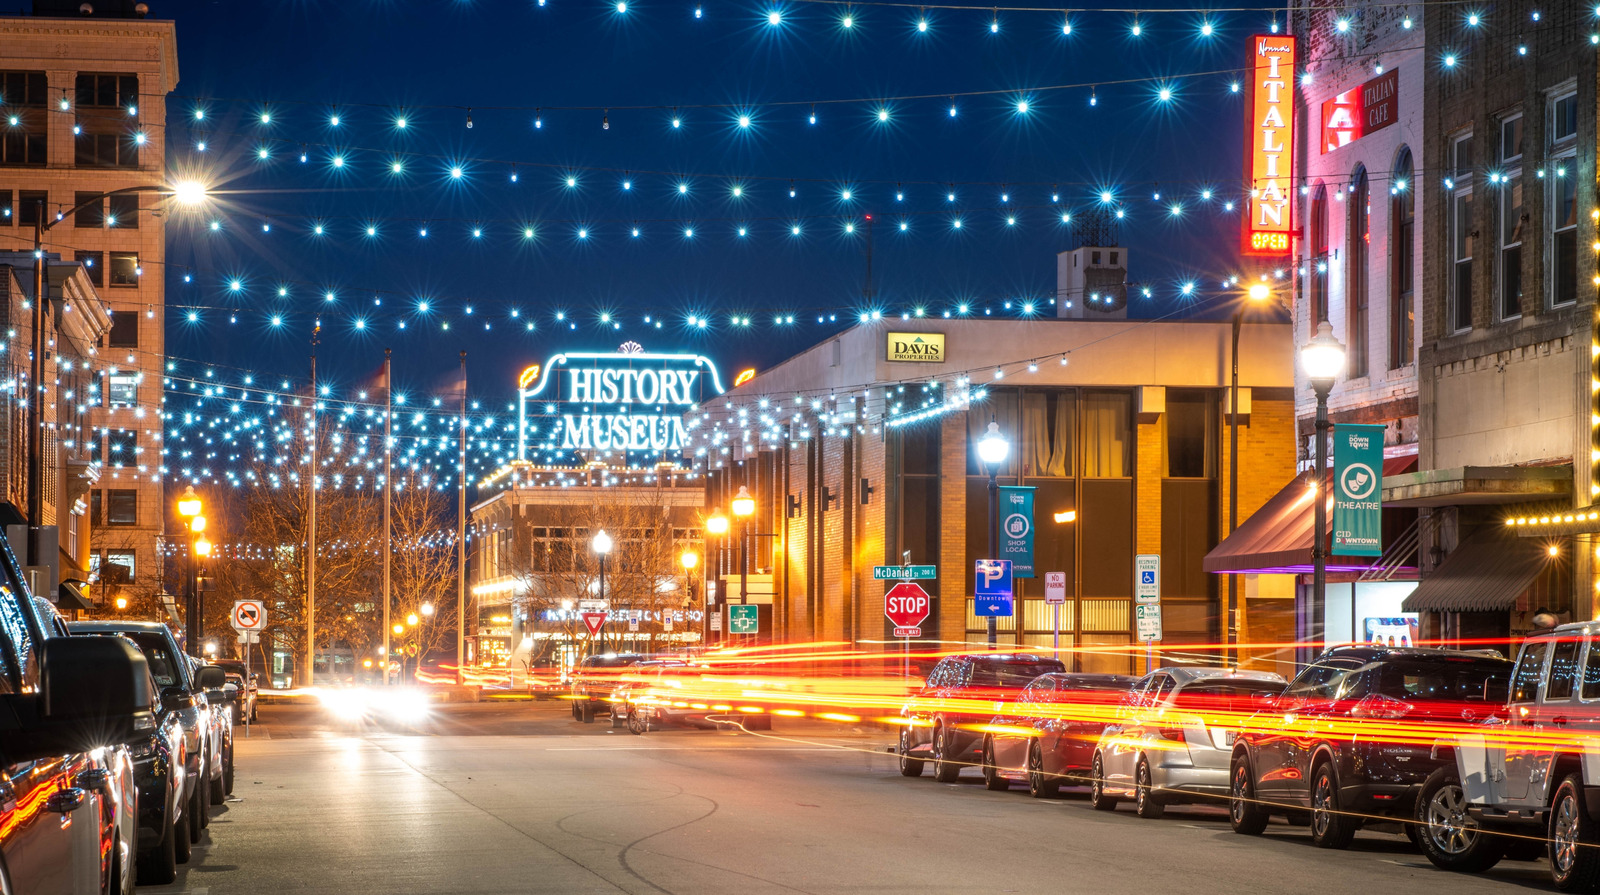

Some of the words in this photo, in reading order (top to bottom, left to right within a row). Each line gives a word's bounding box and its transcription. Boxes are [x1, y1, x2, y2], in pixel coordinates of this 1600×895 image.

[1258, 38, 1291, 57] Nonna's
[1364, 77, 1395, 108] ITALIAN
[1369, 102, 1389, 127] CAFE
[1259, 56, 1285, 226] ITALIAN
[1252, 233, 1288, 249] OPEN
[894, 341, 939, 355] DAVIS
[569, 368, 698, 404] HISTORY
[1337, 501, 1379, 510] THEATRE
[1335, 530, 1352, 538] CID
[1336, 537, 1378, 545] DOWNTOWN
[875, 567, 912, 578] McDaniel
[985, 566, 1003, 588] P
[1047, 581, 1065, 589] PARKING
[888, 596, 926, 614] STOP
[1137, 608, 1144, 618] 2
